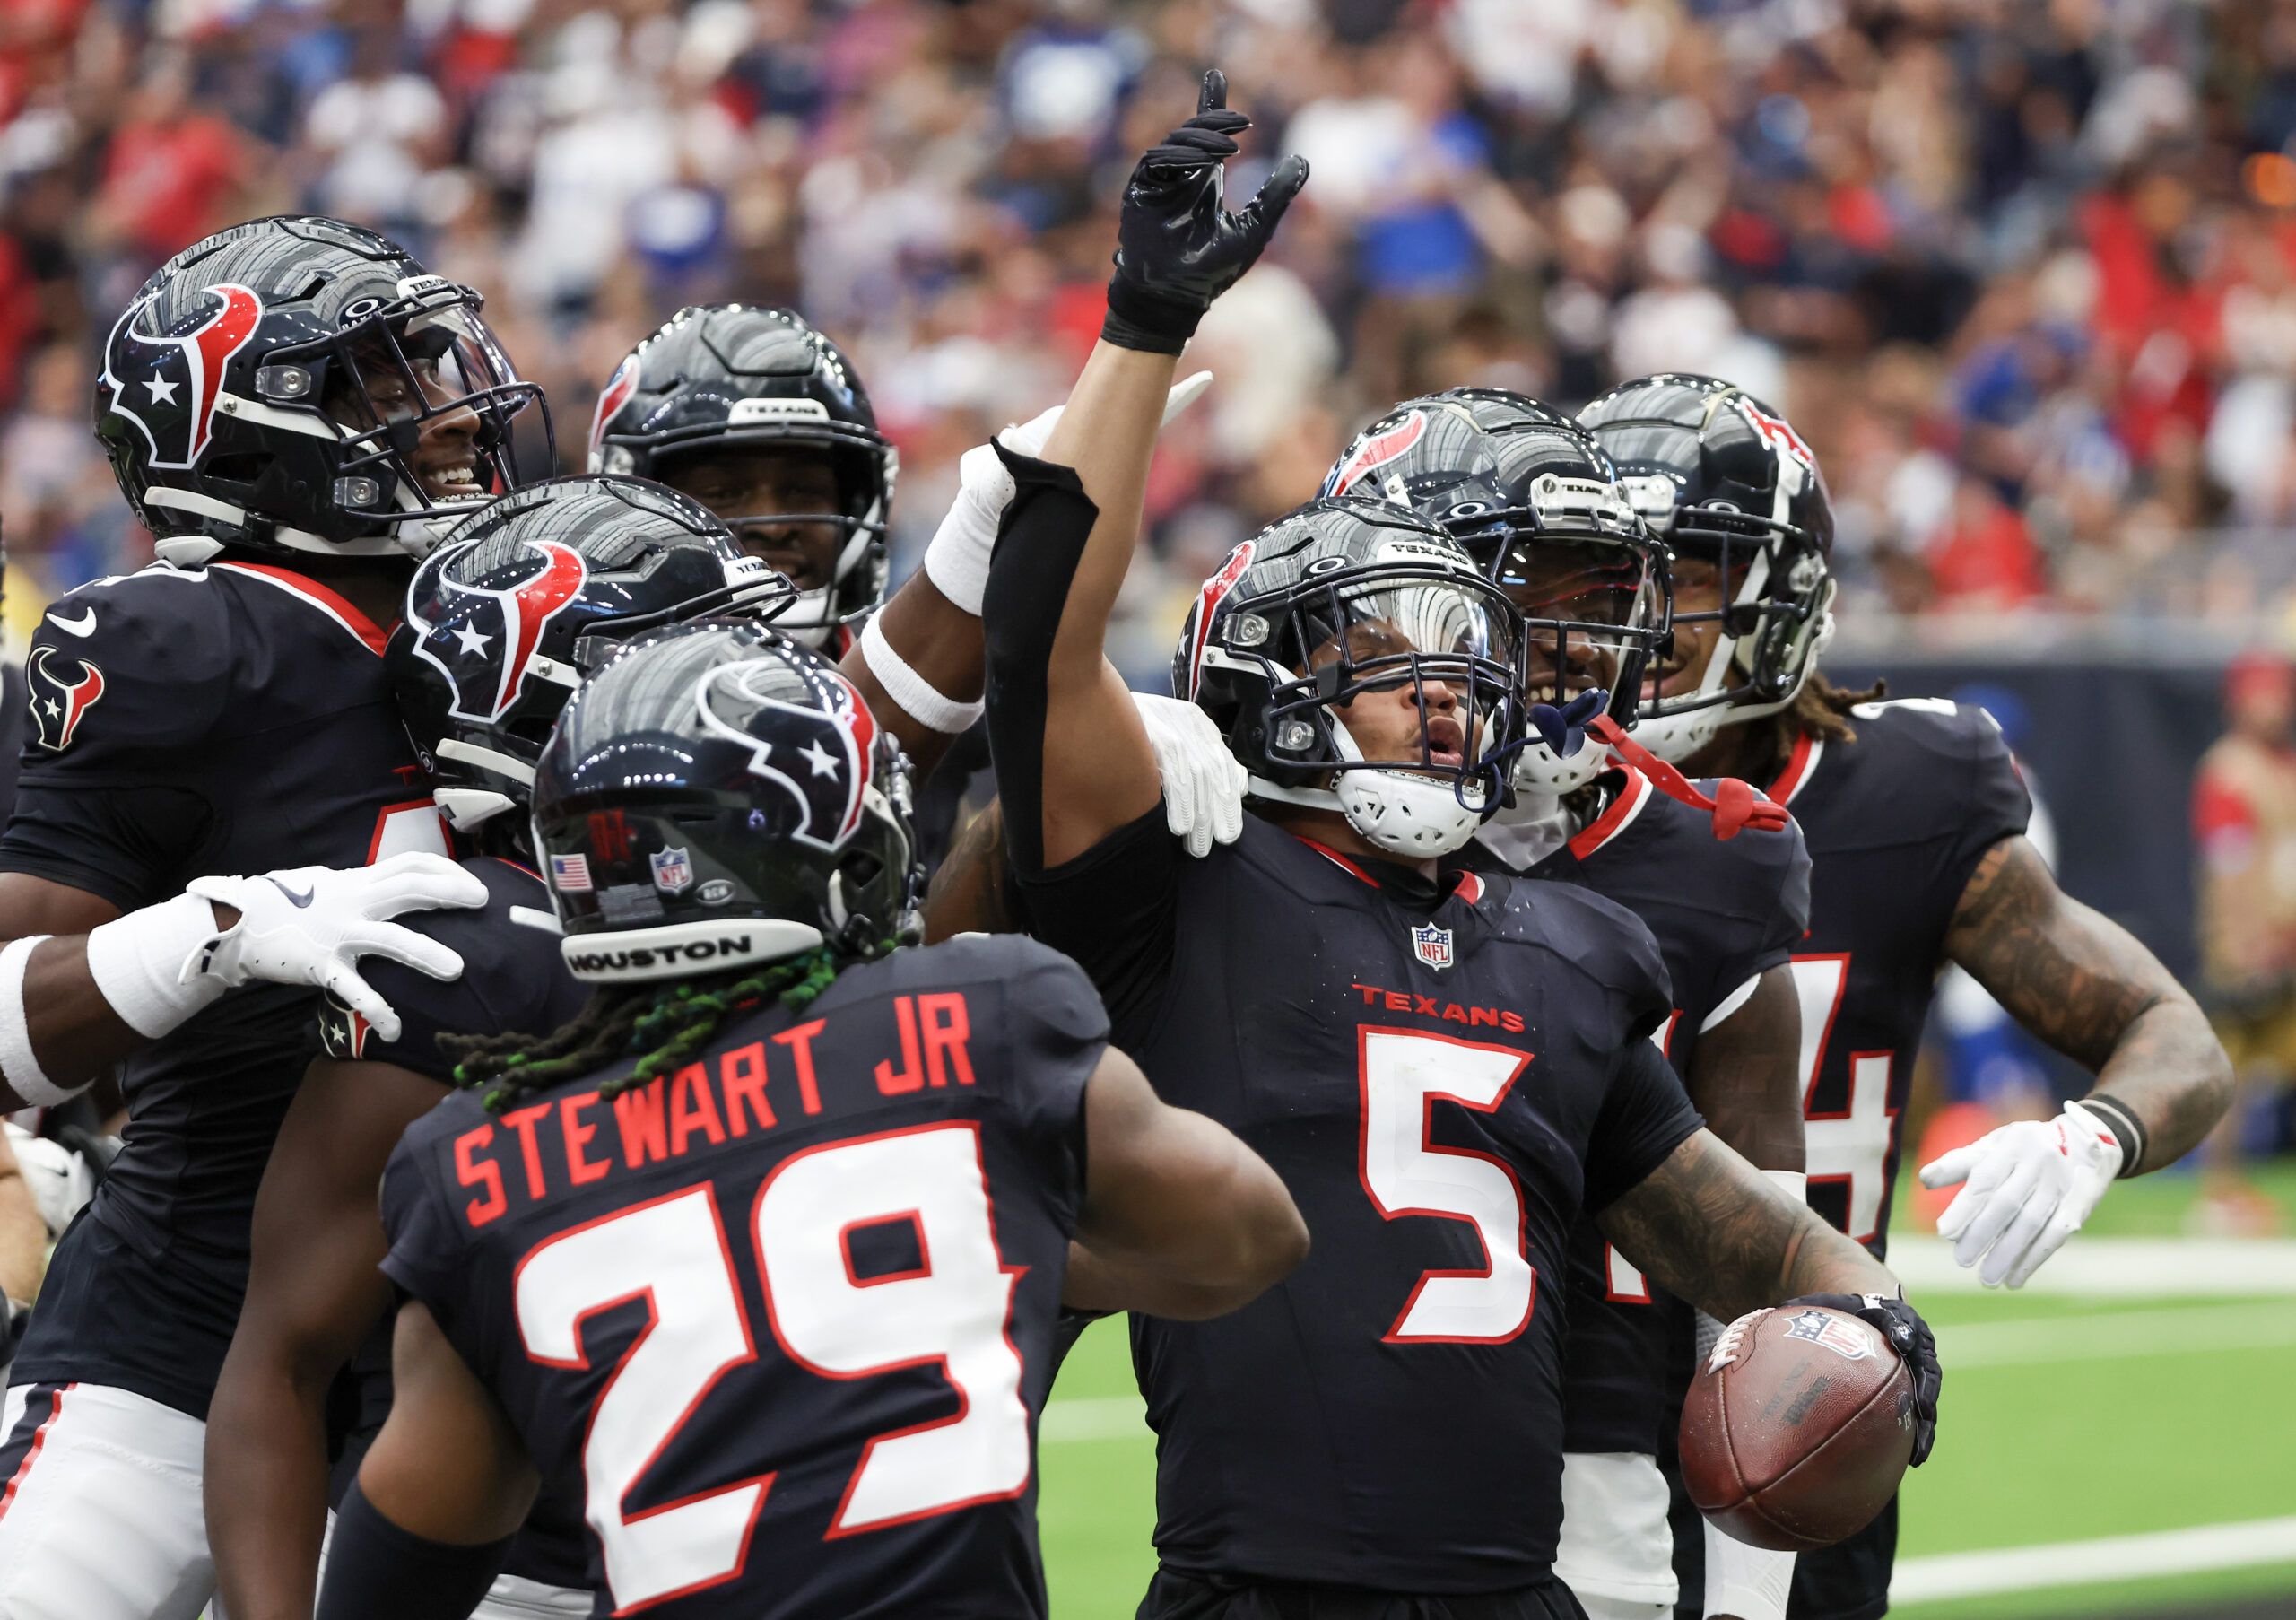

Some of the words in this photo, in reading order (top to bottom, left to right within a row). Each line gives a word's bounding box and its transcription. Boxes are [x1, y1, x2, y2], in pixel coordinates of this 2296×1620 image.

[1391, 544, 1469, 565] TEXANS
[661, 863, 689, 885] NFL
[567, 936, 752, 972] HOUSTON
[1421, 943, 1448, 962] NFL
[1352, 983, 1525, 1032] TEXANS
[454, 1018, 827, 1227] STEWART
[874, 991, 975, 1096] JR
[1357, 1023, 1535, 1345] 5
[512, 1119, 1031, 1620] 29
